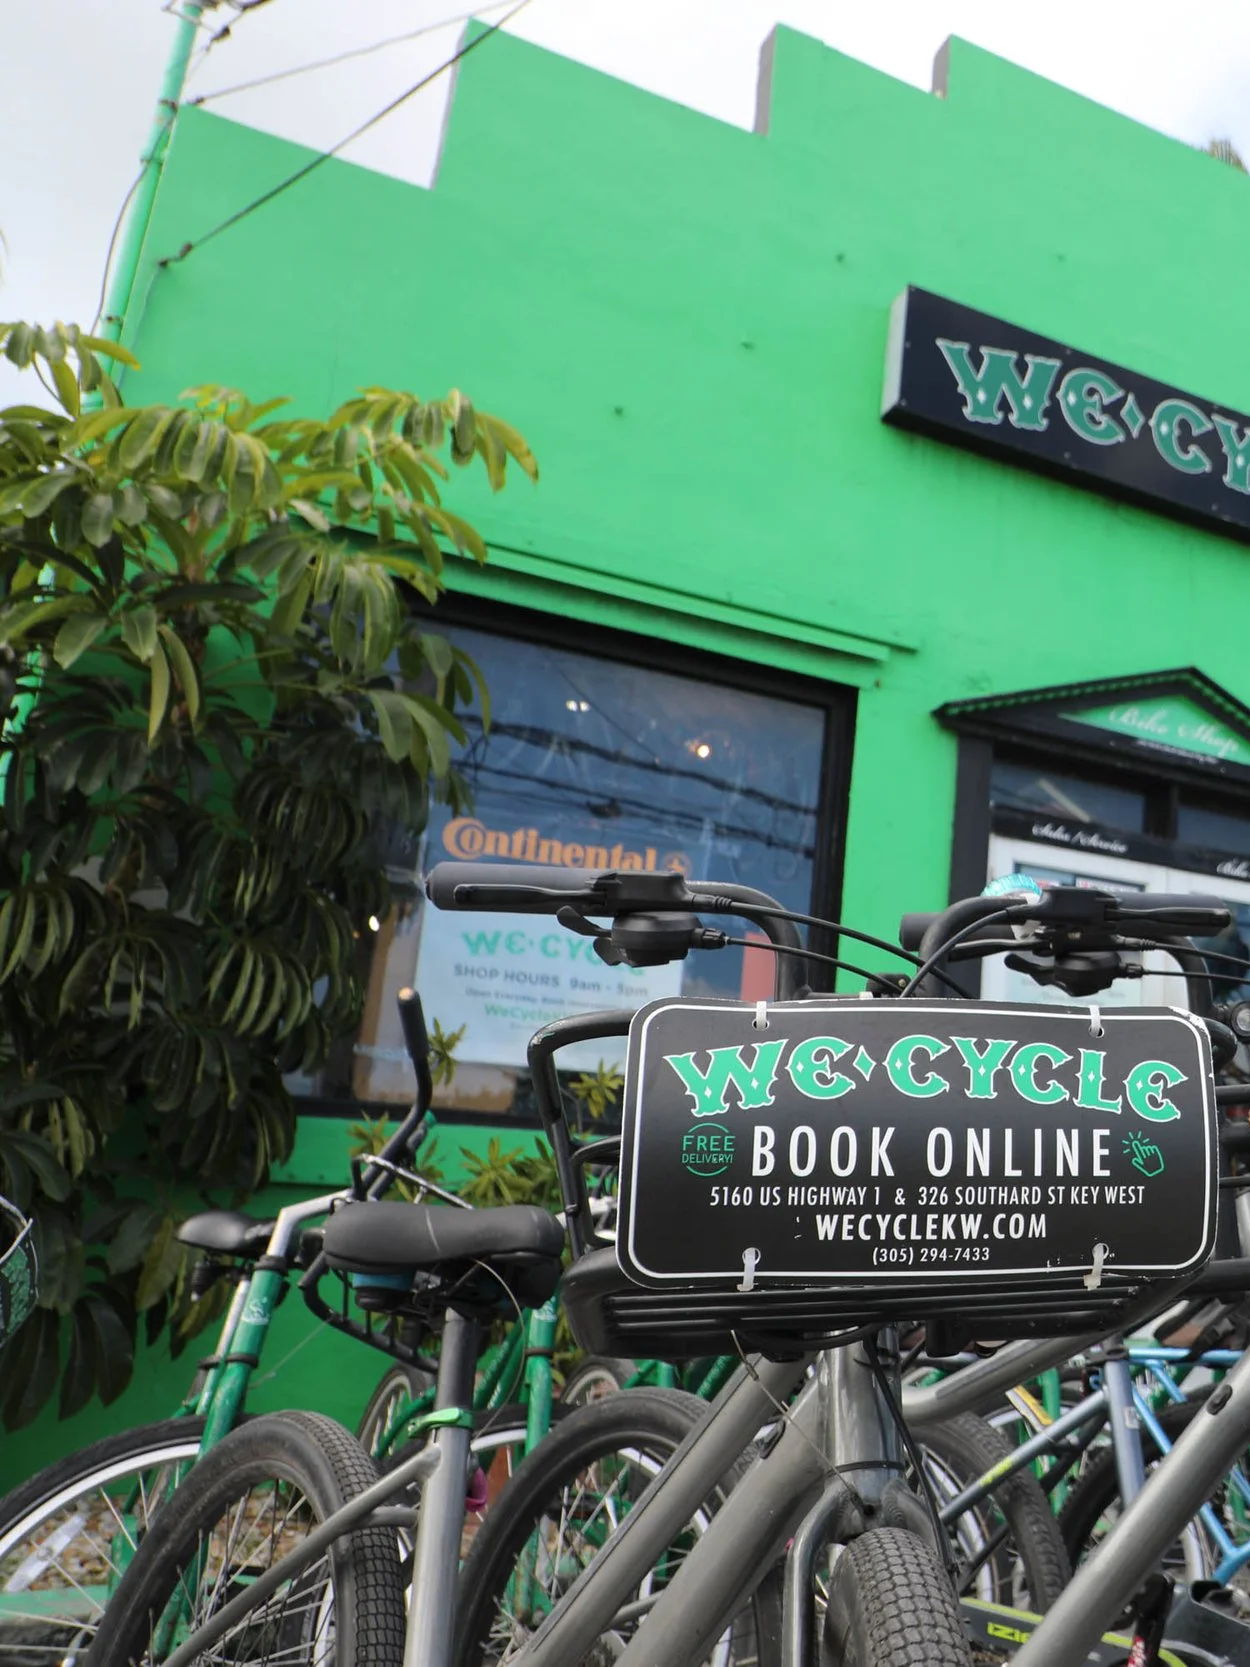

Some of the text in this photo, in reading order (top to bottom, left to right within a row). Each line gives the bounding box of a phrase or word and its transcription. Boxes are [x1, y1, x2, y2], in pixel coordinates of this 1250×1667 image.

[442, 817, 657, 871] Continental
[454, 963, 499, 979] SHOP
[504, 971, 560, 988] HOURS
[683, 1135, 736, 1152] FREE
[752, 1126, 1110, 1177] BOOK ONLINE
[710, 1185, 1145, 1206] 5160 US HIGHWAY 1 & 326 SOUTHARD ST KEY WEST
[816, 1214, 1046, 1241] WECYCLEKW.COM
[872, 1247, 990, 1266] (305) 294-7433
